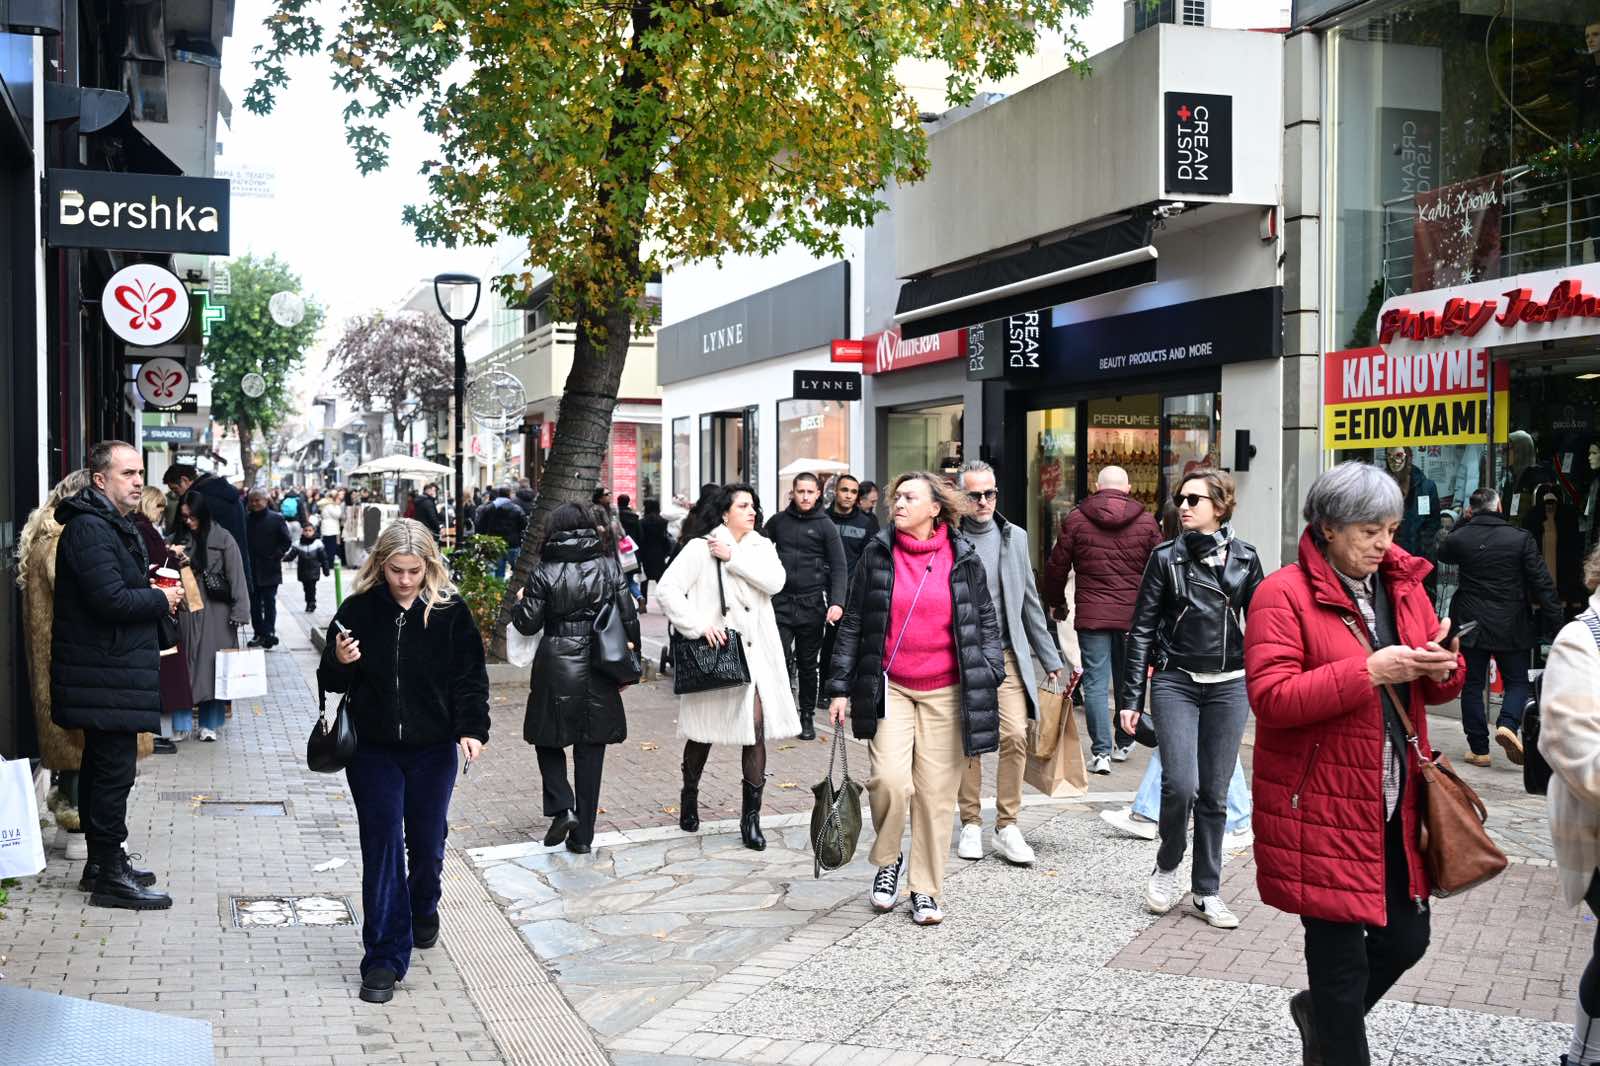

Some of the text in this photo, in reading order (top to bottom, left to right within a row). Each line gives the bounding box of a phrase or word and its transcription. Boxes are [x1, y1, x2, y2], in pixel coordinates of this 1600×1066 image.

[1177, 124, 1192, 180] DUST
[1193, 105, 1209, 181] CREAM
[59, 190, 219, 232] Bershka
[703, 323, 744, 354] LYNNE
[1009, 317, 1025, 368] DUST
[1025, 311, 1040, 368] REAM
[1379, 297, 1497, 344] Funky
[1099, 342, 1213, 369] BEAUTY PRODUCTS AND MORE
[1342, 348, 1485, 399] ΚΛΕΙΝΟΥΜΕ
[801, 380, 854, 390] LYNNE
[1093, 415, 1150, 425] PERFUME
